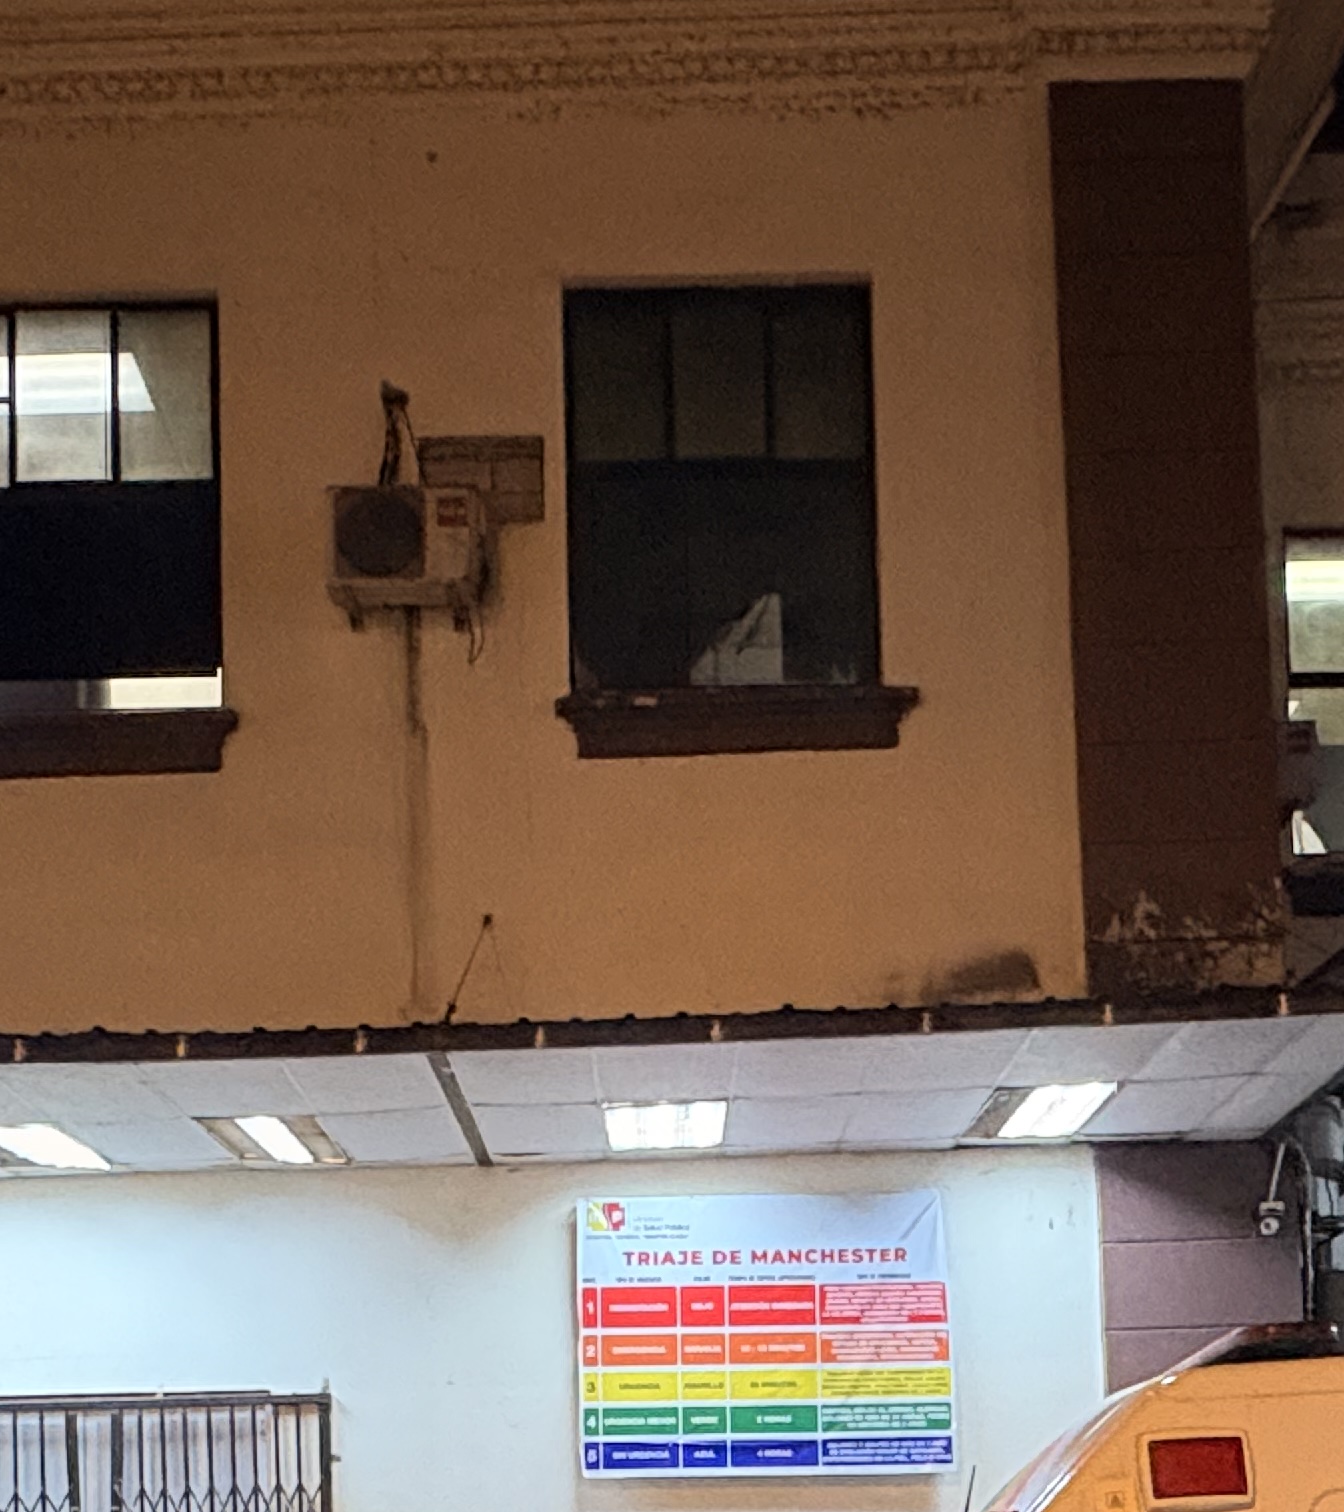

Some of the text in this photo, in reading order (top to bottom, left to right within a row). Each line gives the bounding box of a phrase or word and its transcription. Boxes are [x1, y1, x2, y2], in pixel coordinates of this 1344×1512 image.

[622, 1247, 908, 1266] TRIAJE DE MANCHESTER
[586, 1301, 595, 1315] 1
[585, 1344, 596, 1358] 2
[586, 1381, 596, 1394] 3
[586, 1414, 597, 1429] 4
